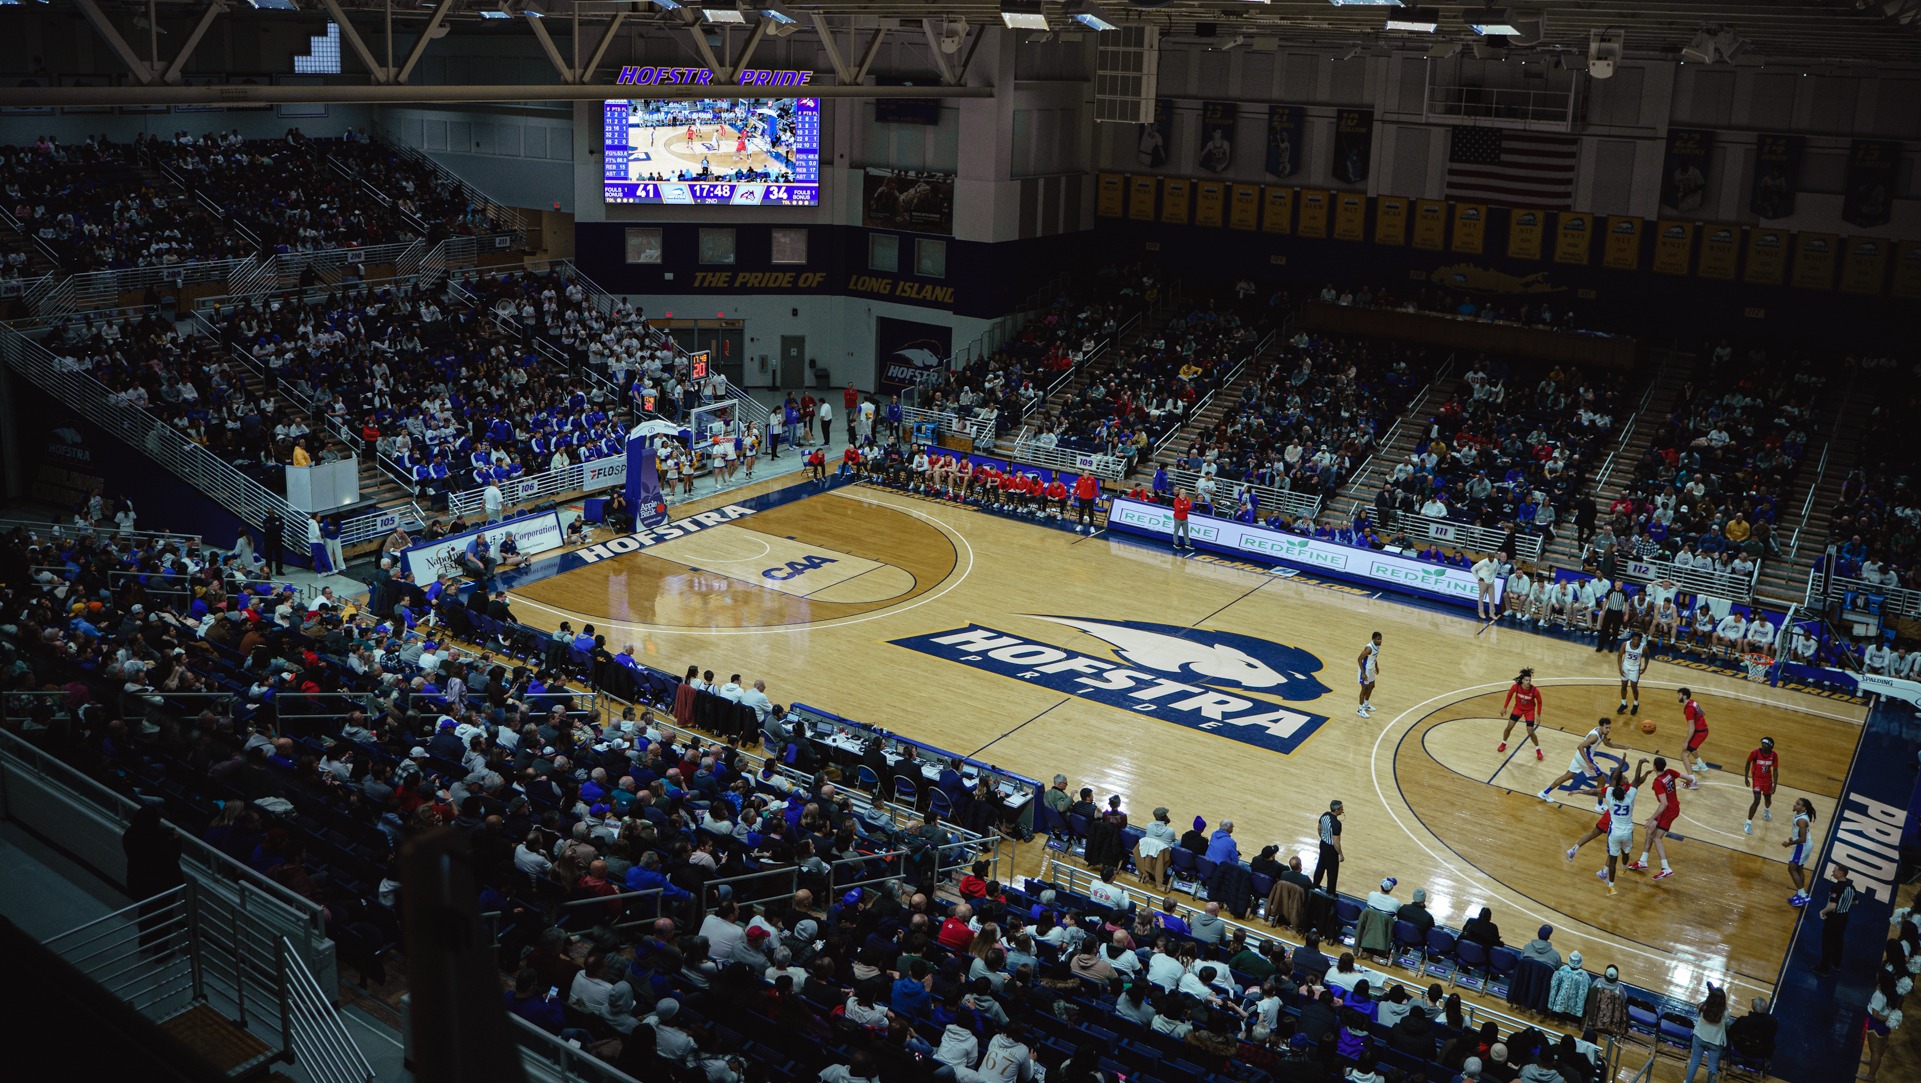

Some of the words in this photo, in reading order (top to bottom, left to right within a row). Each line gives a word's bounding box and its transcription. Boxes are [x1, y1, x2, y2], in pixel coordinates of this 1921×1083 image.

[616, 66, 714, 86] HOFSTR
[739, 69, 813, 86] PRIDE
[1341, 112, 1359, 126] 10
[636, 184, 654, 197] 41
[694, 185, 730, 197] 17:48
[770, 187, 788, 200] 34
[166, 270, 181, 279] 209
[693, 272, 732, 288] THE
[734, 272, 796, 288] PRIDE
[797, 272, 827, 288] OF
[848, 275, 892, 294] LONG
[895, 281, 954, 303] ISLAND
[693, 363, 706, 378] 20
[48, 442, 90, 462] HOFSTRA
[1080, 458, 1093, 467] 109
[521, 483, 535, 493] 106
[640, 501, 657, 512] Apple
[640, 508, 656, 519] Bank
[380, 516, 395, 527] 105
[1124, 512, 1214, 538] REDENE
[514, 524, 557, 542] Corporation
[574, 505, 757, 563] HOFSTRA
[1435, 527, 1447, 536] 111
[1245, 538, 1342, 565] REDEFINE
[762, 555, 839, 580] CAA
[1632, 564, 1650, 574] 112
[1376, 566, 1479, 594] REDEFINE
[929, 629, 1312, 738] HOFSTRA
[1862, 676, 1893, 686] SPALDING
[960, 656, 1223, 730] PRIDE
[1614, 804, 1630, 816] 23
[1824, 792, 1908, 904] PRIDE
[985, 1050, 1015, 1076] 67
